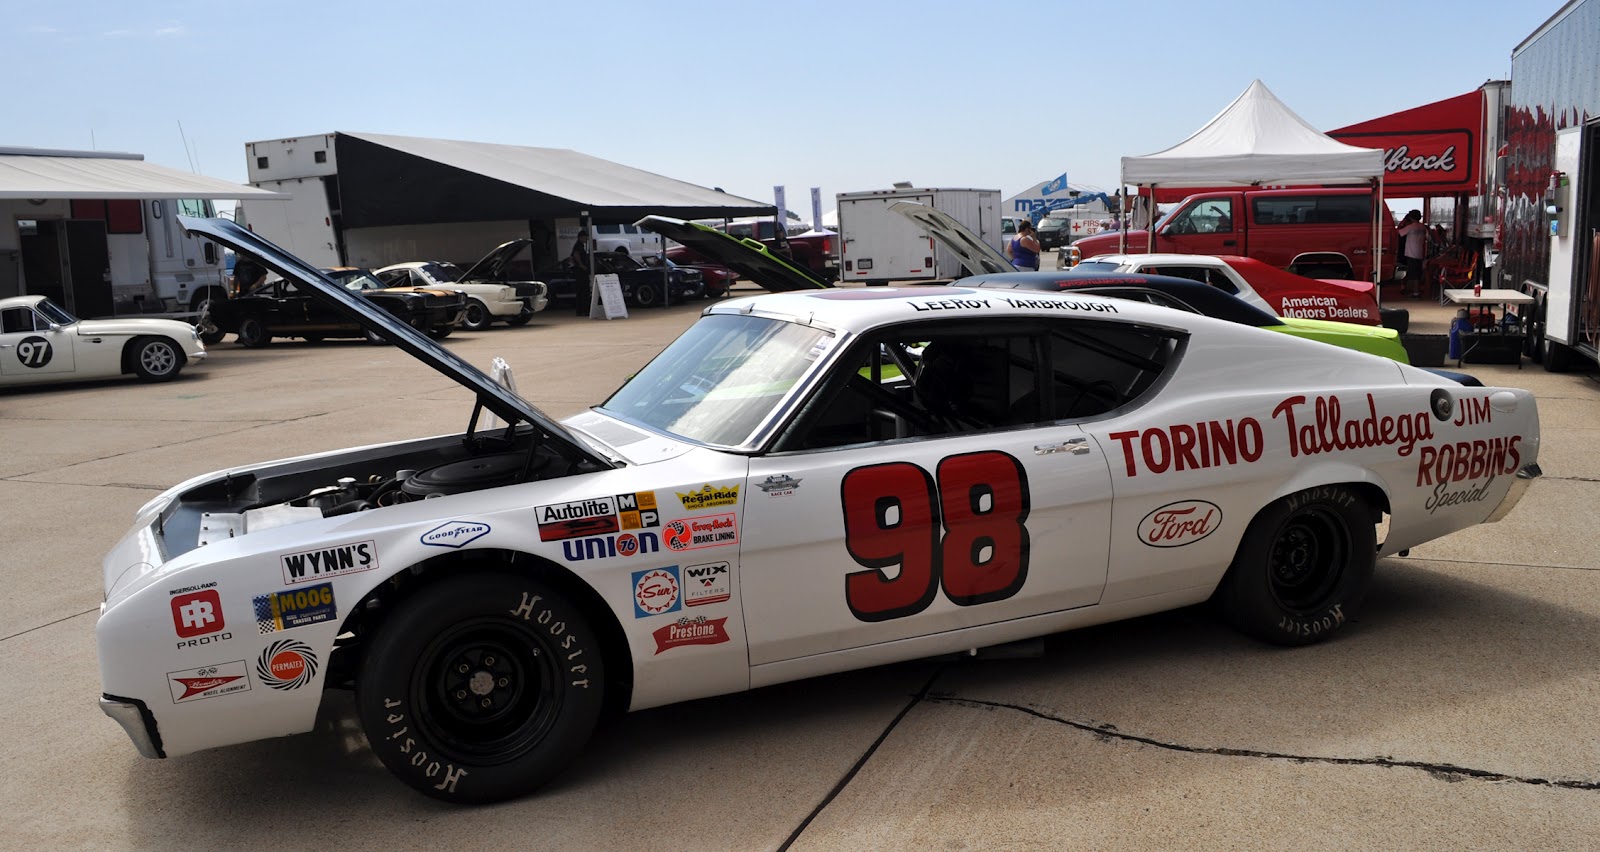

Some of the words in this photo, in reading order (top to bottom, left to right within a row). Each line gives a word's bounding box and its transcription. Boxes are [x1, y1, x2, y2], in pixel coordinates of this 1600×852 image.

[1383, 145, 1455, 171] lbrock
[907, 298, 992, 312] LEEROY
[997, 298, 1119, 314] YARBROUGH
[1282, 296, 1338, 308] American
[1283, 307, 1326, 318] Motors
[1328, 306, 1369, 318] Dealers
[19, 342, 48, 364] 97
[1454, 396, 1491, 427] JIM
[1109, 417, 1264, 477] TORINO
[1272, 393, 1434, 457] Talladega
[1416, 435, 1522, 487] ROBBINS
[1425, 473, 1495, 515] Special
[544, 501, 609, 522] Autolite
[1148, 506, 1215, 544] Ford
[620, 538, 636, 552] 76
[693, 533, 714, 544] BRAKE
[715, 531, 735, 541] LINING
[841, 450, 1030, 623] 98
[284, 544, 371, 578] WYNN'S
[687, 565, 727, 577] WIX
[280, 587, 332, 612] MOOG
[643, 584, 671, 598] Sun
[691, 588, 725, 597] FILTERS
[177, 632, 232, 650] PROTO
[509, 592, 589, 689] Hoosier
[670, 624, 714, 640] Prestone
[272, 660, 304, 672] PERMATEX
[384, 698, 468, 792] Hoosier
